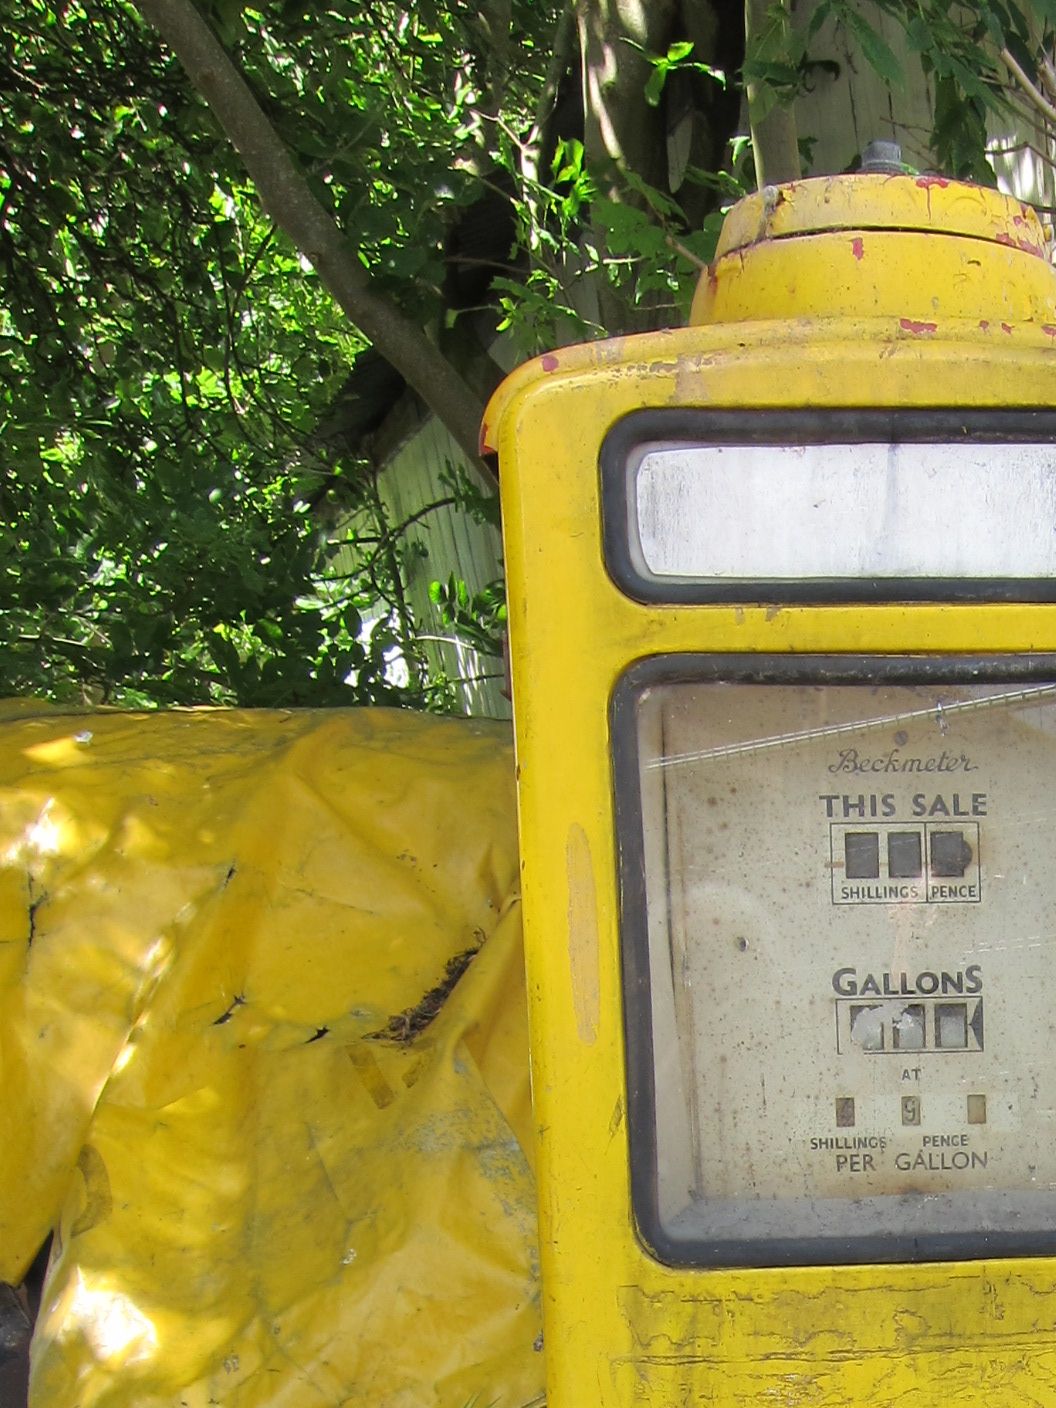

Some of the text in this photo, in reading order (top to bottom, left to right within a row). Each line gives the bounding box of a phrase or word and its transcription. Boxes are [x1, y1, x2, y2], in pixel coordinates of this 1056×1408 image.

[828, 749, 979, 773] Beckmeter
[819, 793, 987, 817] THIS SALE
[841, 885, 976, 899] SHILLINGS PENCE
[832, 965, 983, 996] GALLONS
[901, 1068, 921, 1080] AT
[811, 1134, 969, 1150] SHILLINGS PENCE
[836, 1151, 988, 1173] PER GALLON
